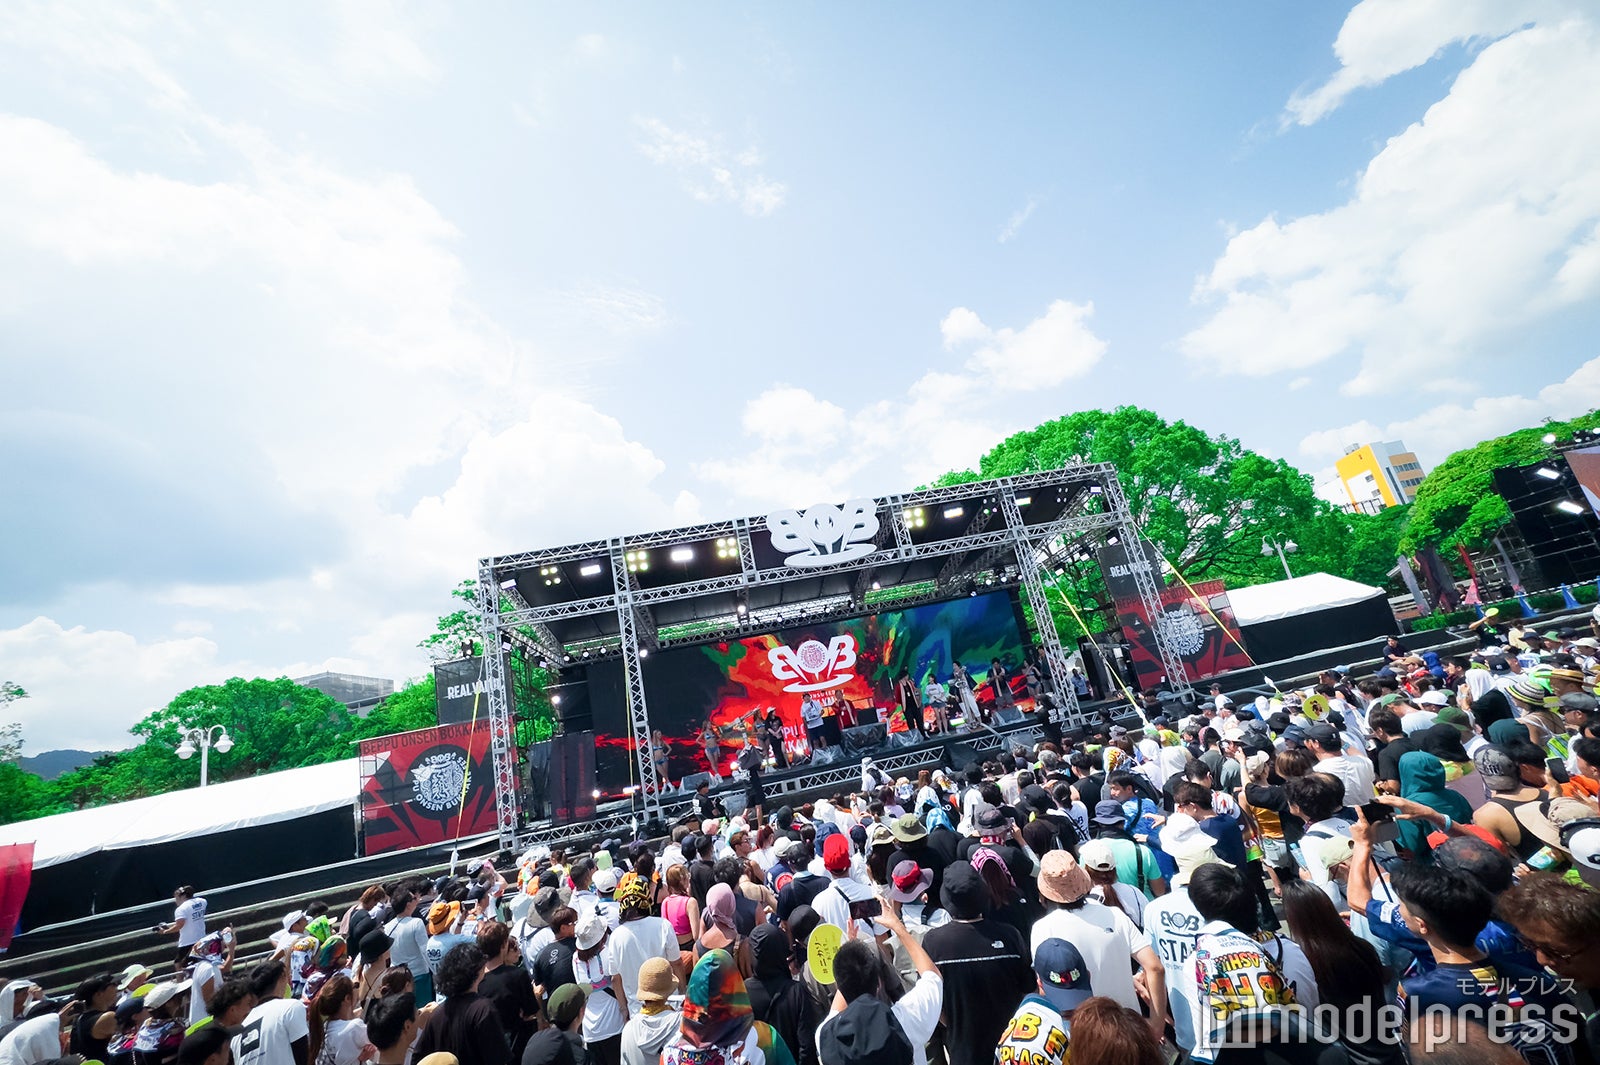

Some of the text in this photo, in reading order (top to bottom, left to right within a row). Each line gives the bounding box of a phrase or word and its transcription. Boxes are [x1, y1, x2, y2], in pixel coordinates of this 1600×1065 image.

[447, 683, 472, 699] REAL
[363, 736, 399, 755] BEPPU
[401, 730, 437, 747] ONSEN
